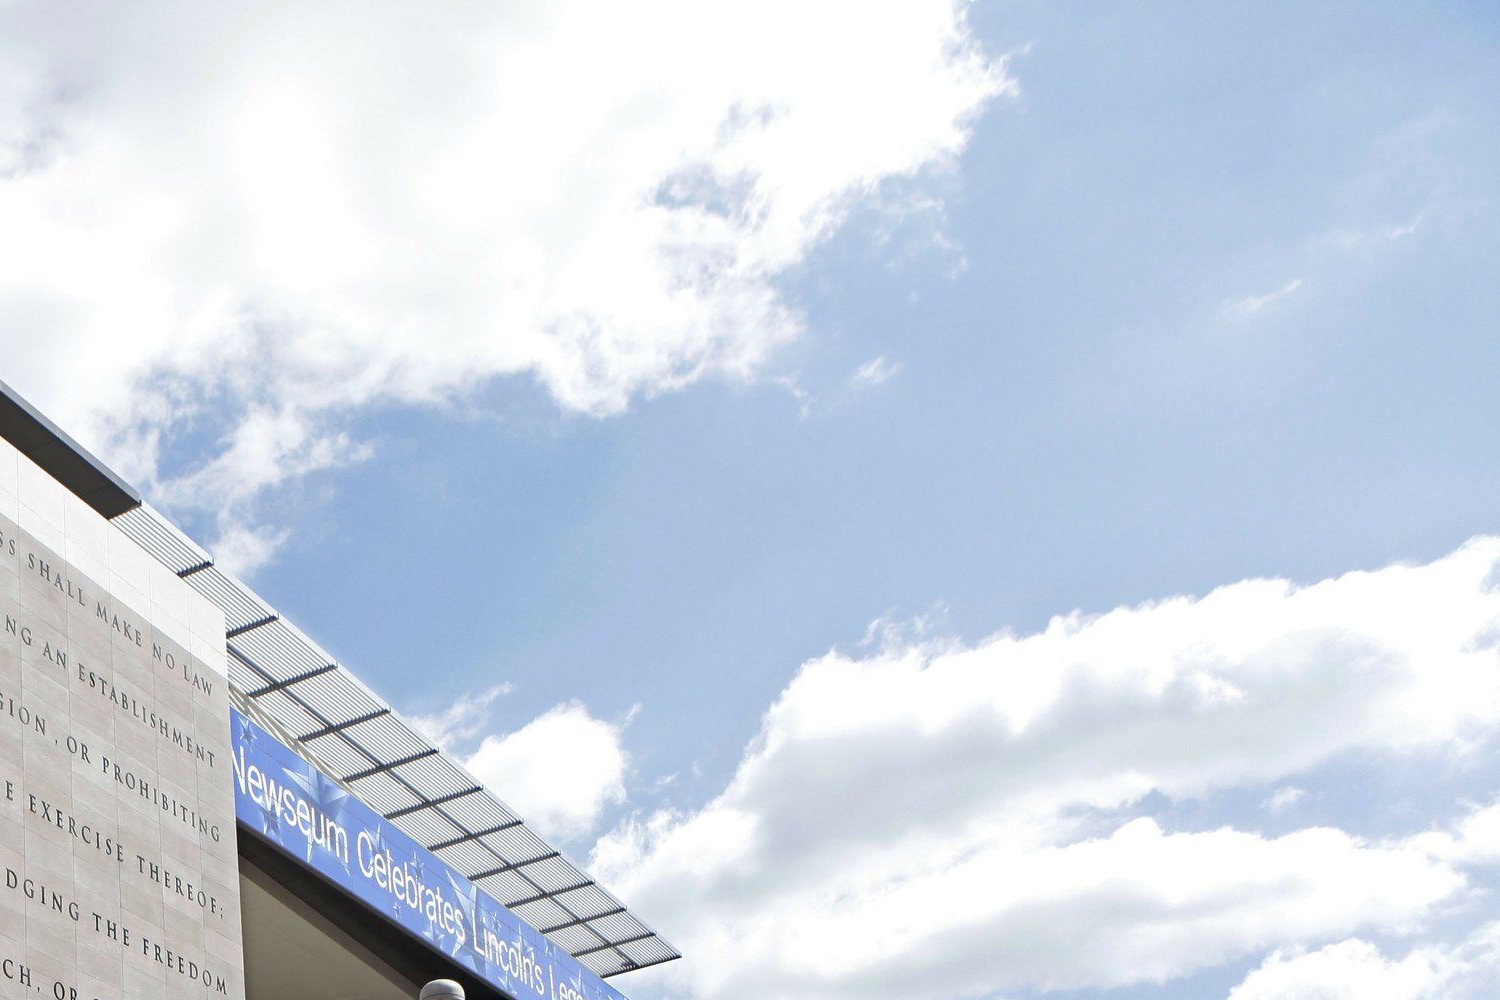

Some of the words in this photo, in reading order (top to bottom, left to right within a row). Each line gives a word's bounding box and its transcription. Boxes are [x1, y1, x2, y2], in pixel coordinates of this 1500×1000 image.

[28, 553, 85, 606] SHALL
[96, 602, 142, 647] MAKE
[153, 646, 175, 670] NO
[184, 665, 212, 697] LAW
[43, 642, 66, 670] AN
[79, 663, 215, 768] ESTABLISHMENT
[67, 735, 91, 764] OR
[102, 756, 220, 843] PROHIBITING
[29, 794, 124, 863] EXERCISE
[137, 856, 223, 920] THEREOF;
[231, 746, 348, 864] Newseum
[358, 832, 465, 942] Celebrates
[472, 910, 544, 995] Lincoln's
[93, 913, 129, 947] THE
[143, 938, 227, 995] FREEDOM
